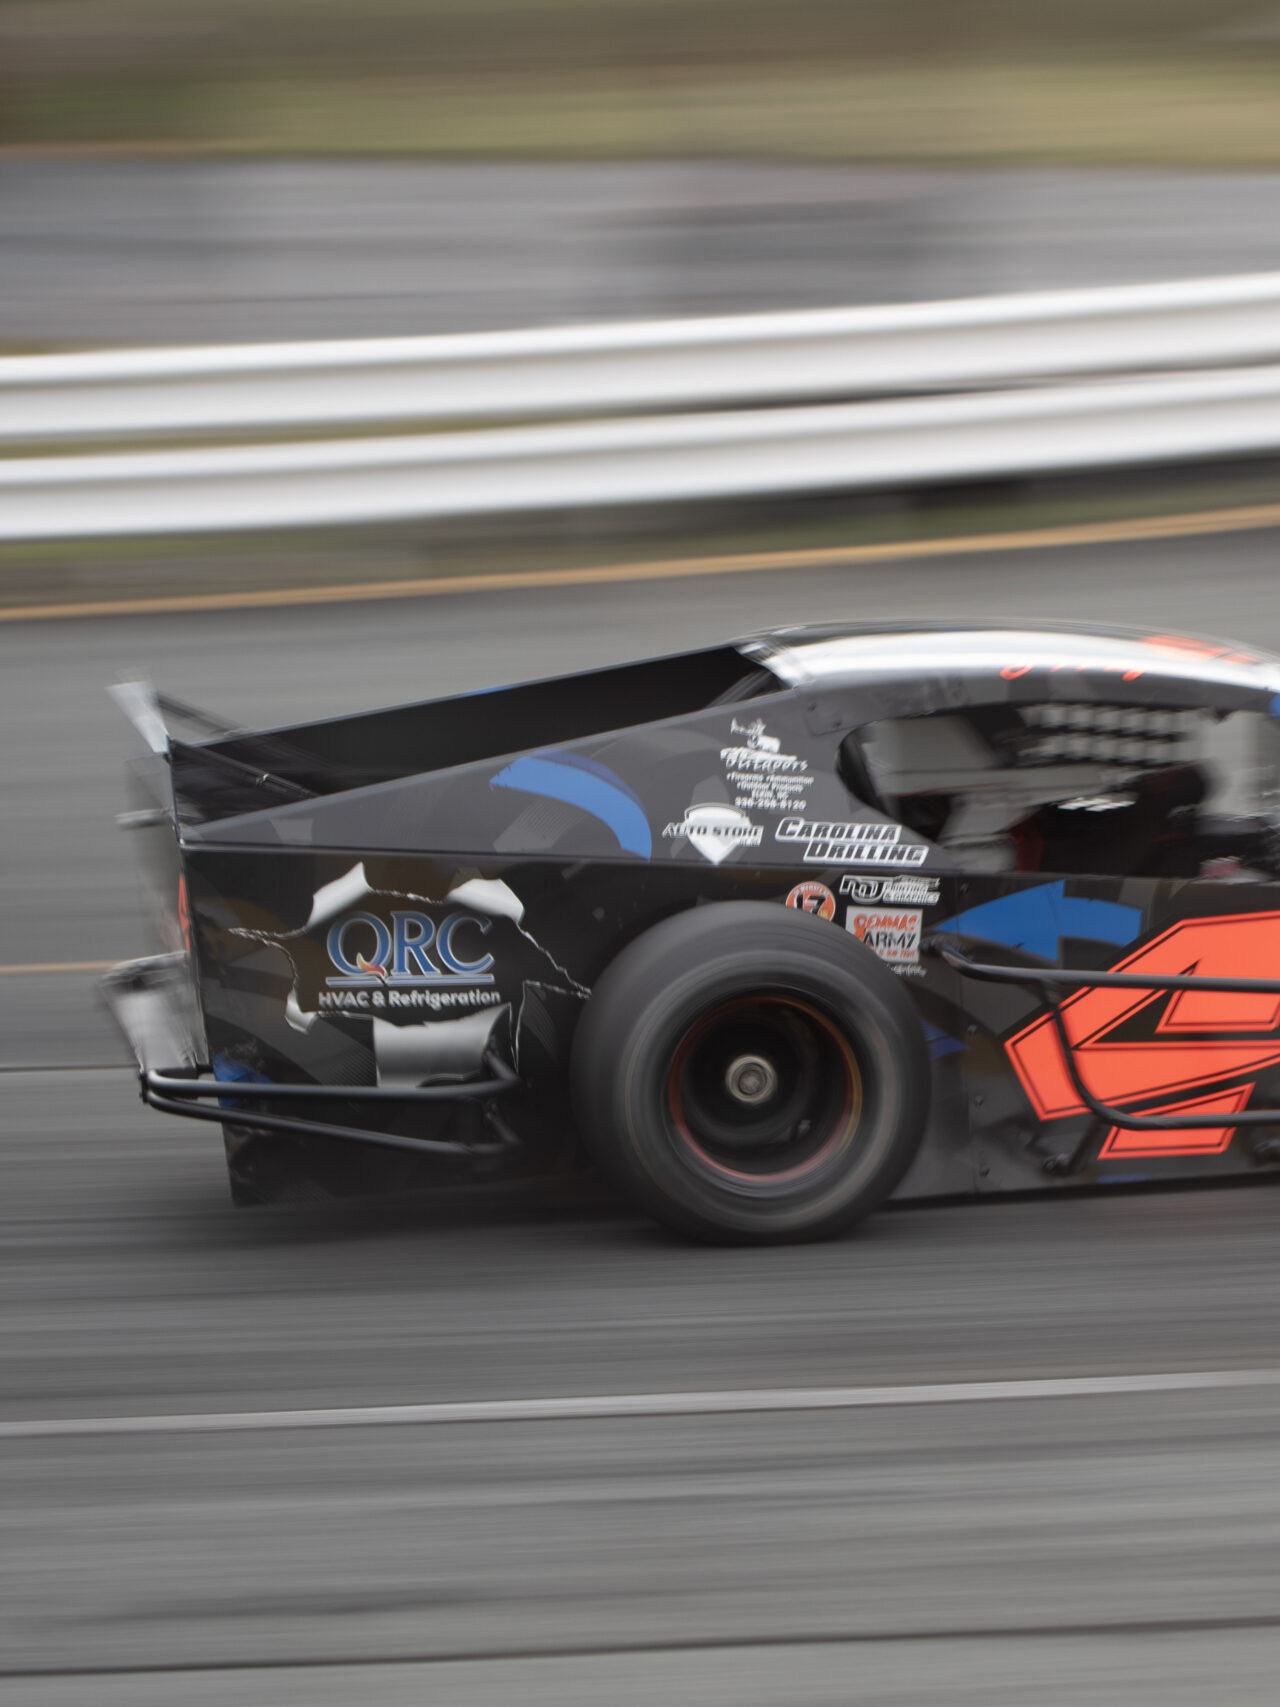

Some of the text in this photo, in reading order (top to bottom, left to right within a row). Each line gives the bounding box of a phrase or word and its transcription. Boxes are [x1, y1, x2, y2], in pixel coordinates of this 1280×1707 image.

[662, 822, 707, 839] AUTO
[775, 817, 902, 843] CAROLINA
[803, 839, 929, 867] DRILLING
[327, 911, 496, 979] QRC
[863, 931, 916, 949] ARMY
[318, 989, 502, 1012] HVAC & Refrigeration
